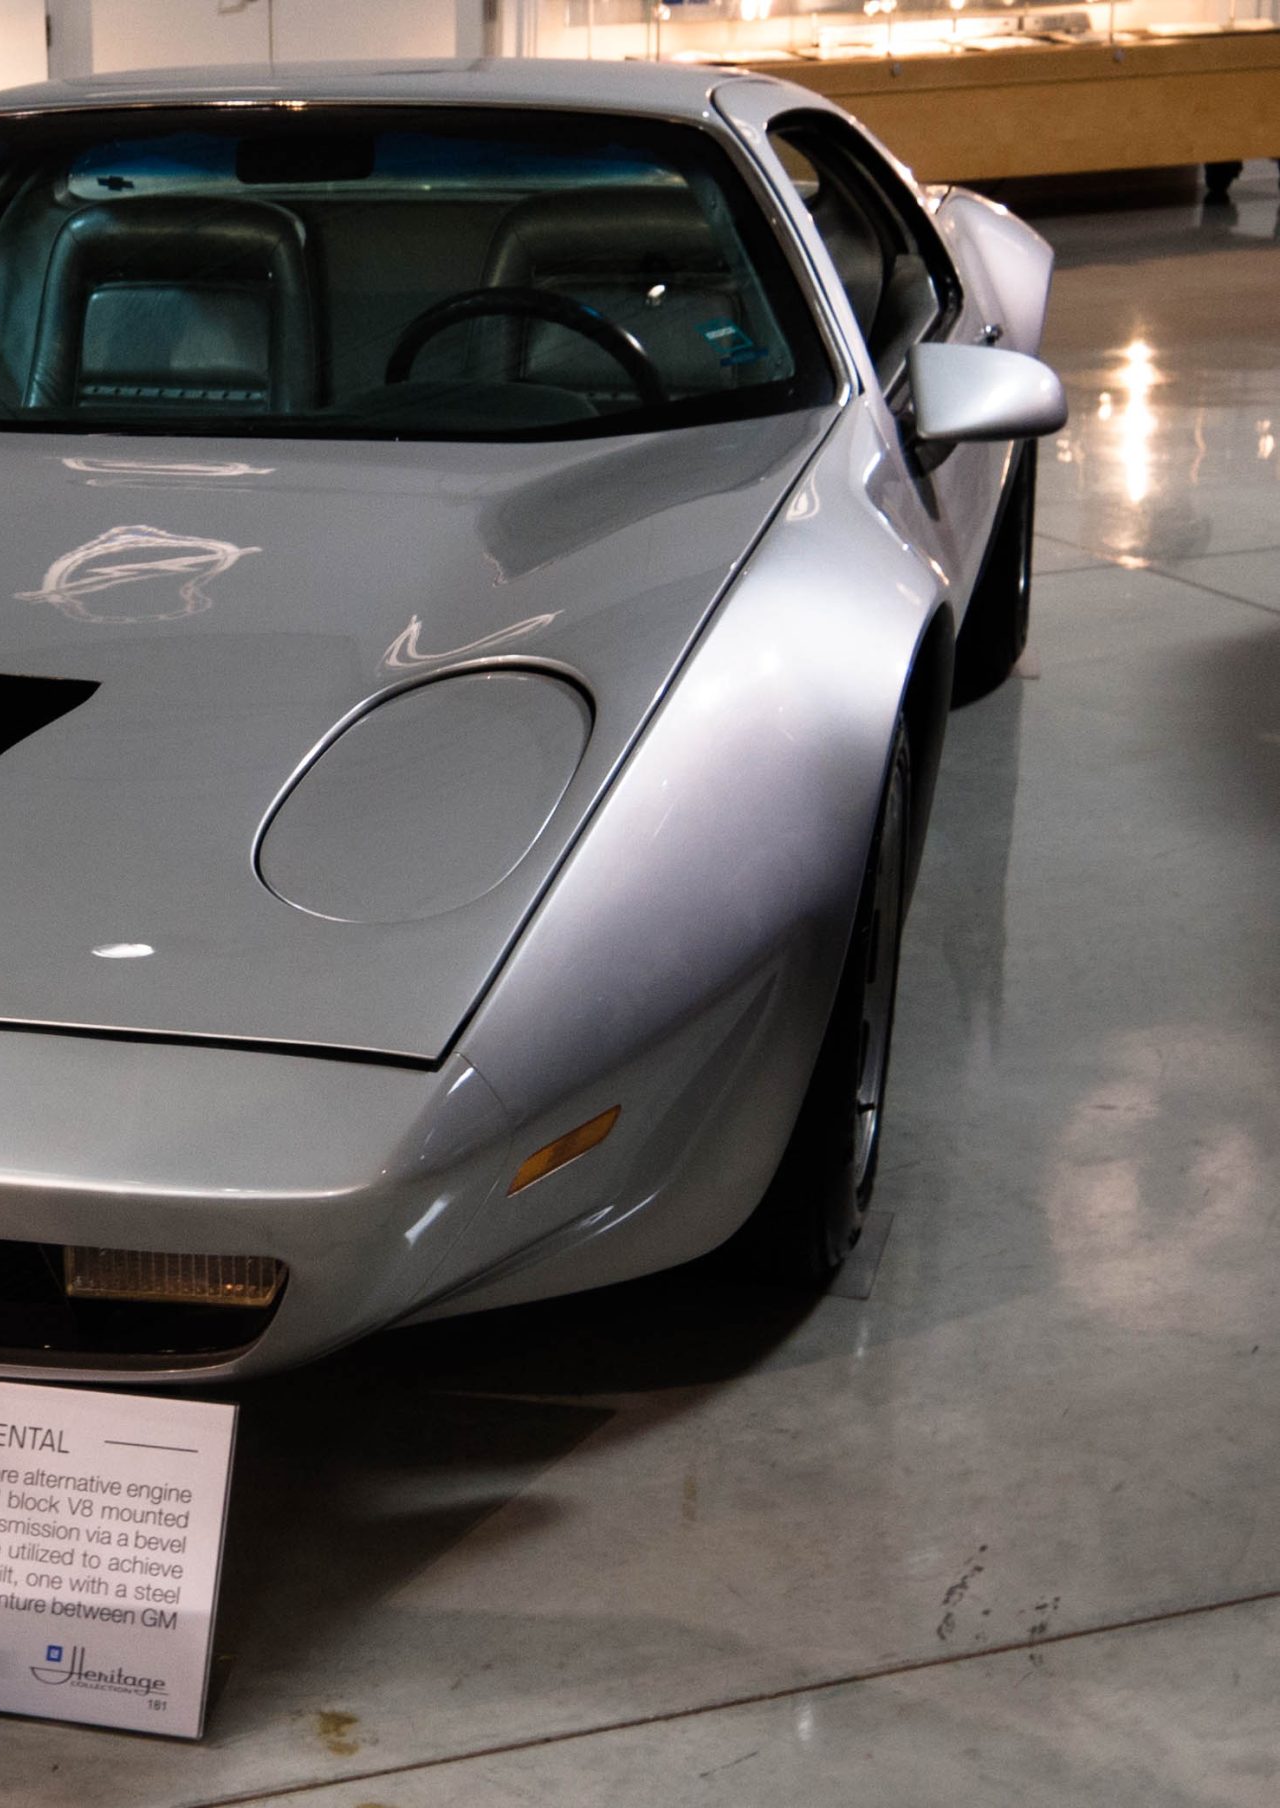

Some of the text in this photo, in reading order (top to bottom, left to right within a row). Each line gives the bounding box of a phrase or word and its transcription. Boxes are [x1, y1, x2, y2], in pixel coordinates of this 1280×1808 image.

[22, 1468, 122, 1495] alternative
[126, 1483, 192, 1505] engine
[7, 1490, 60, 1514] block
[67, 1497, 93, 1517] V8
[100, 1504, 190, 1529] mounted
[85, 1526, 112, 1545] via
[116, 1532, 129, 1547] a
[133, 1529, 187, 1554] bevel
[8, 1542, 75, 1566] utilized
[81, 1550, 101, 1569] to
[107, 1555, 183, 1579] achieve
[25, 1572, 63, 1590] one
[69, 1575, 109, 1595] with
[114, 1583, 127, 1598] a
[133, 1583, 181, 1604] steel
[50, 1596, 135, 1625] between
[140, 1607, 178, 1630] GM
[29, 1645, 166, 1696] Heritage
